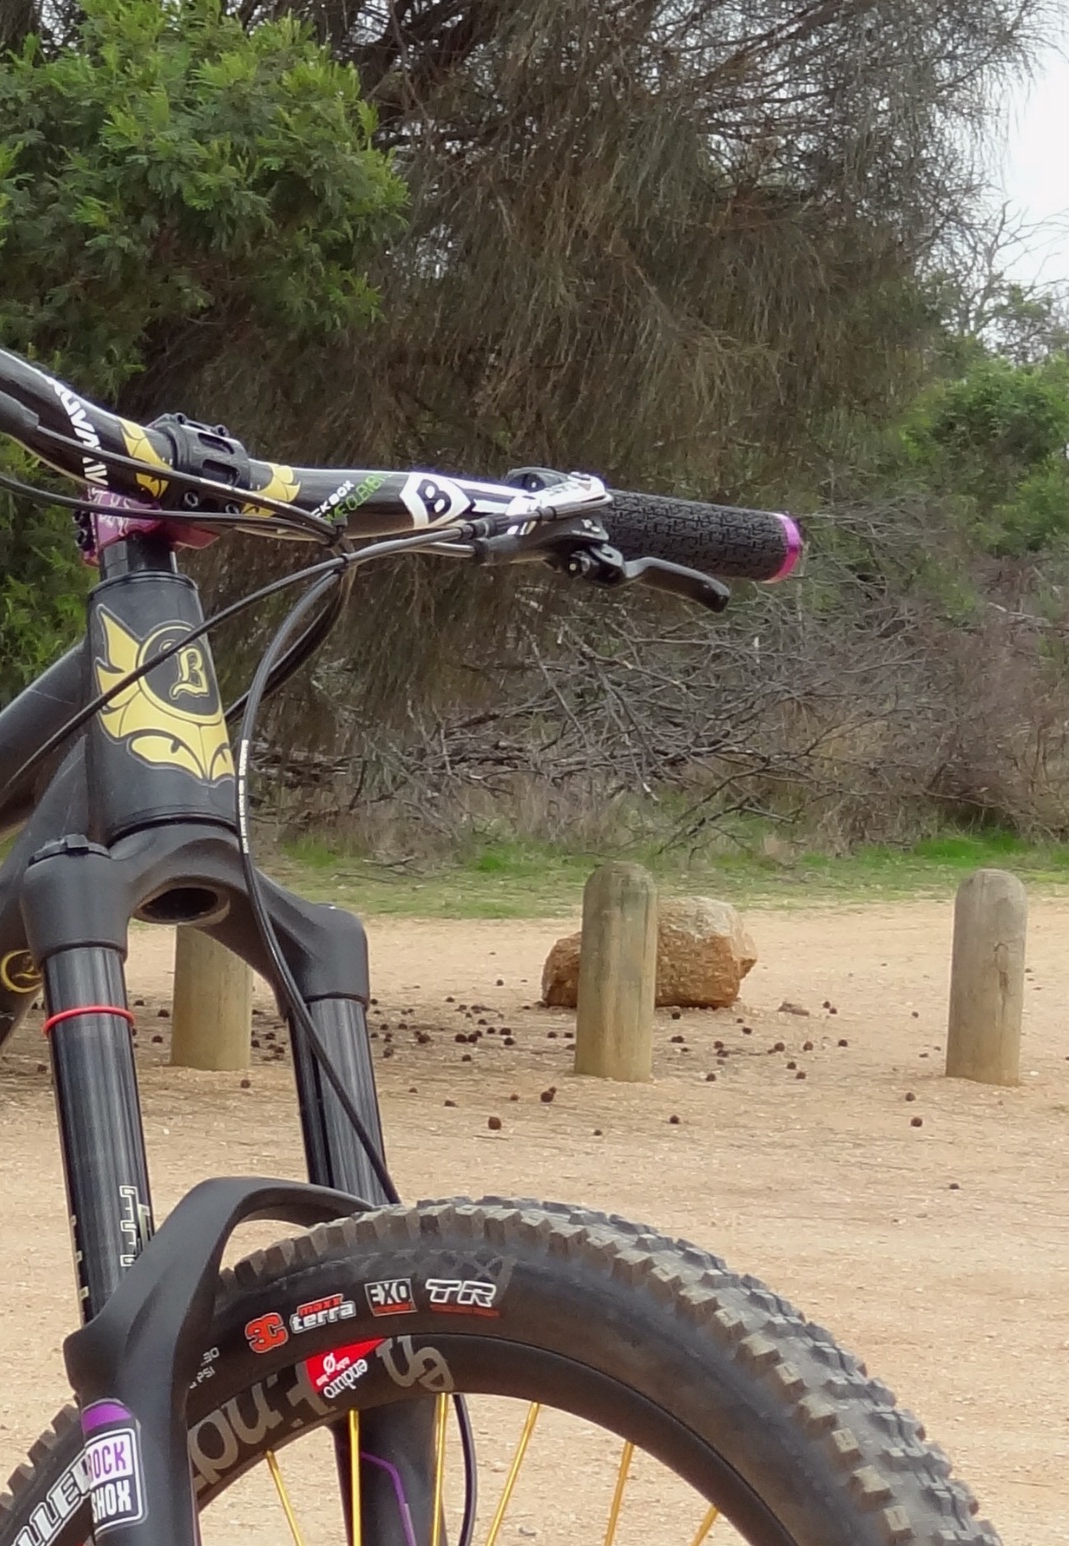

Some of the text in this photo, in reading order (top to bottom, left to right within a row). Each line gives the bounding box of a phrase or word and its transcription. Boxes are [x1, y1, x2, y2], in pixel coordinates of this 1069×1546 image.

[366, 1279, 414, 1307] EXO
[425, 1277, 497, 1309] TR
[290, 1299, 357, 1335] terra
[322, 1357, 369, 1399] enduro
